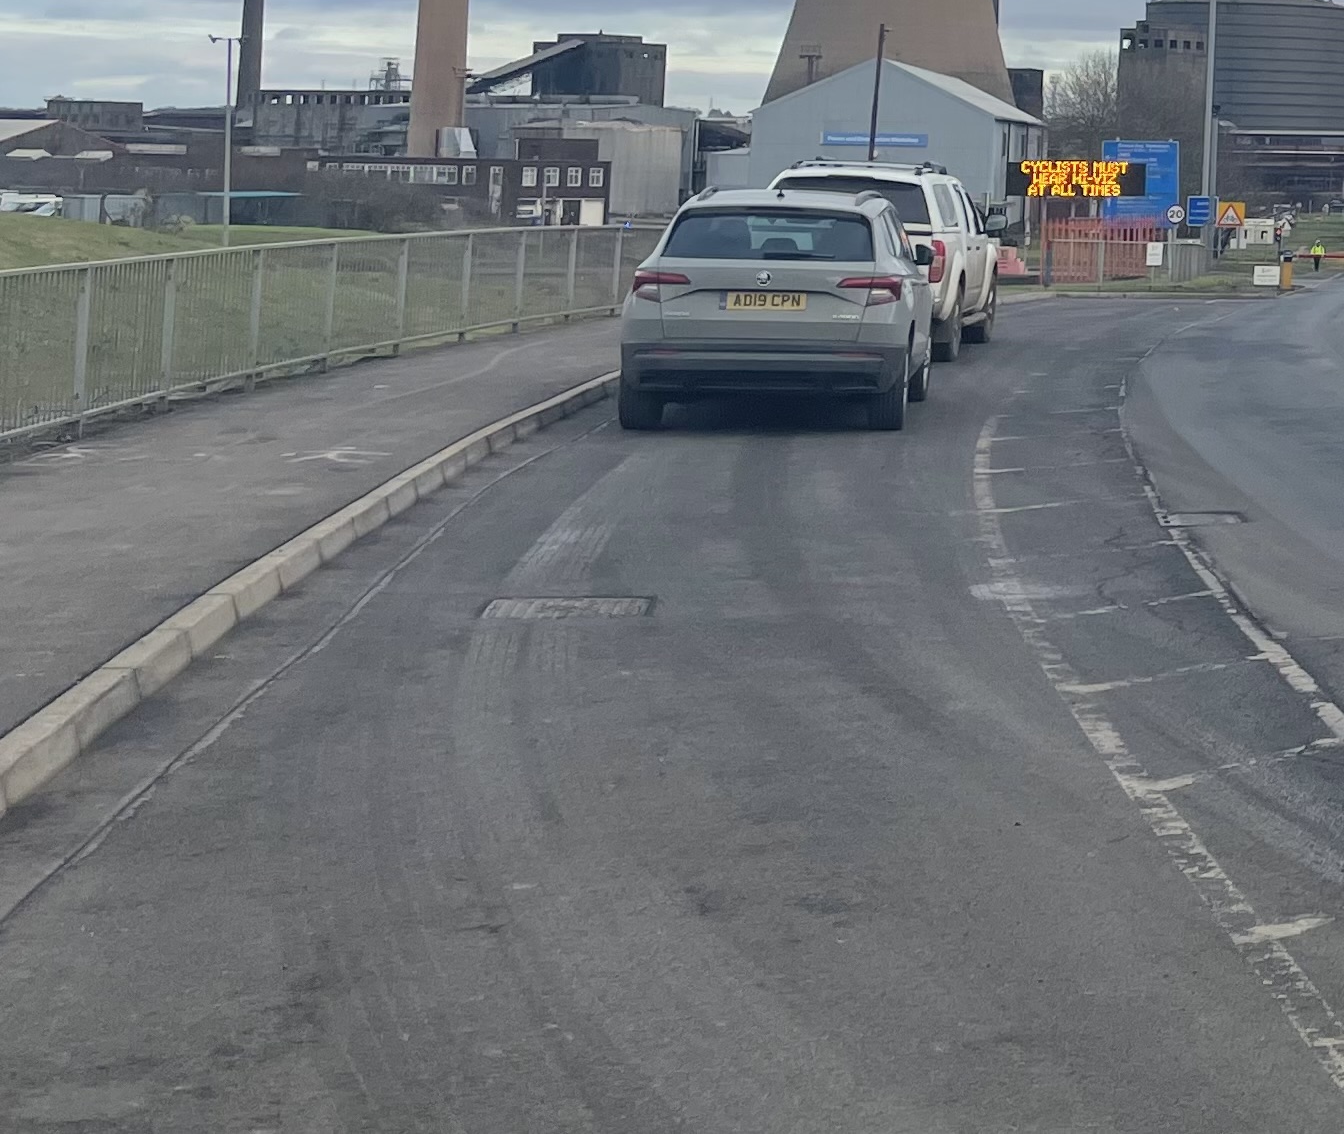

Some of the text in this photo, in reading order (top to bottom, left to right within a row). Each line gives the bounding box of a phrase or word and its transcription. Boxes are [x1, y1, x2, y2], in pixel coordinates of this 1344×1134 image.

[1020, 160, 1128, 174] CYCLISTS MUST
[1032, 172, 1117, 185] WEAR HI-VIZ
[1027, 184, 1121, 196] AT ALL TIMES
[1169, 209, 1183, 219] 20
[733, 293, 801, 307] AD19 CPN
